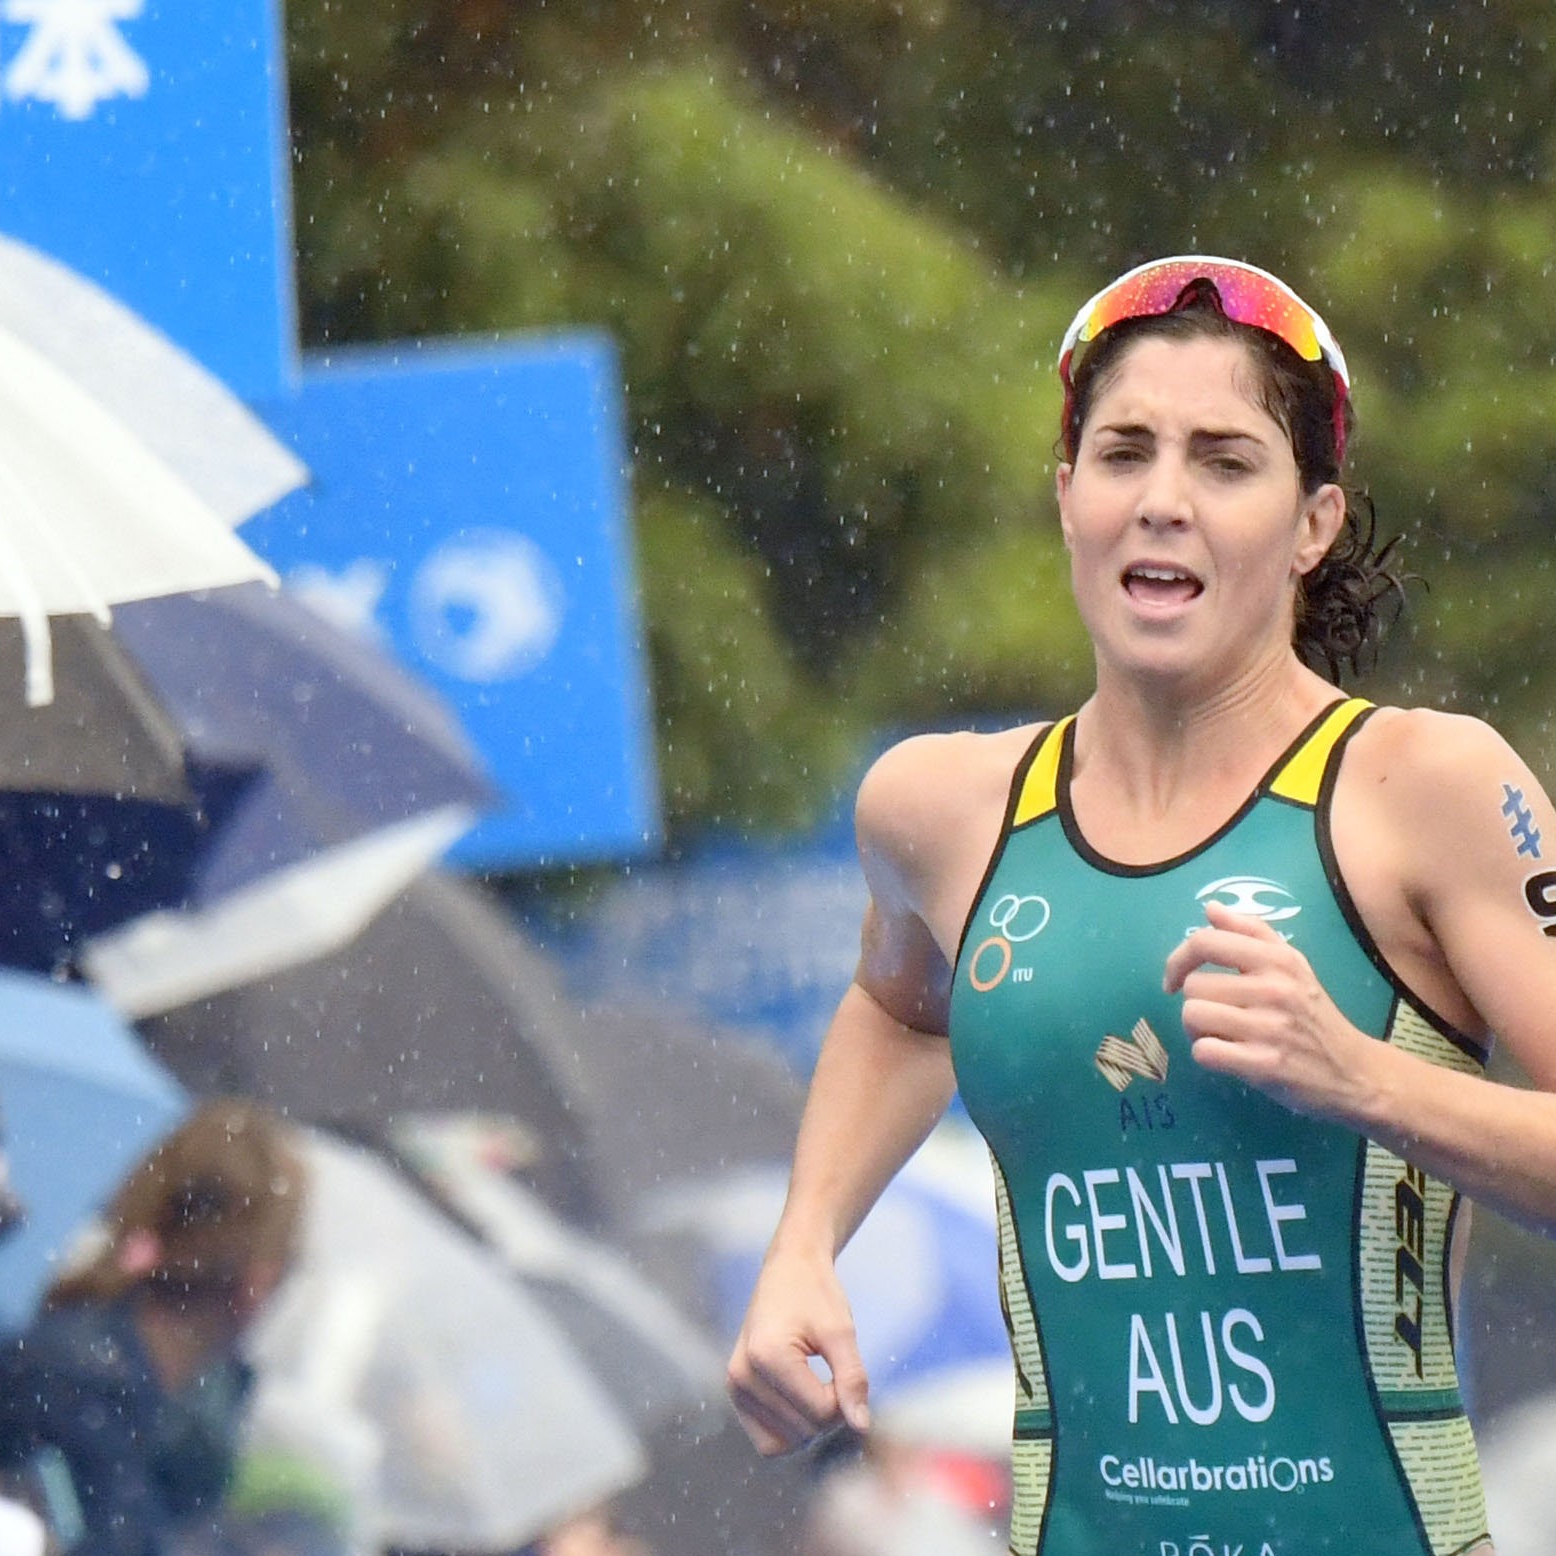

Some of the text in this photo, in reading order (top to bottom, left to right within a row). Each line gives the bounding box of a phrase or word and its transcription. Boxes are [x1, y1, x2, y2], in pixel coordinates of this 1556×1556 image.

[1013, 967, 1034, 983] ITU
[1119, 1094, 1176, 1131] AIS
[1044, 1159, 1321, 1282] GENTLE
[1127, 1308, 1276, 1426] AUS
